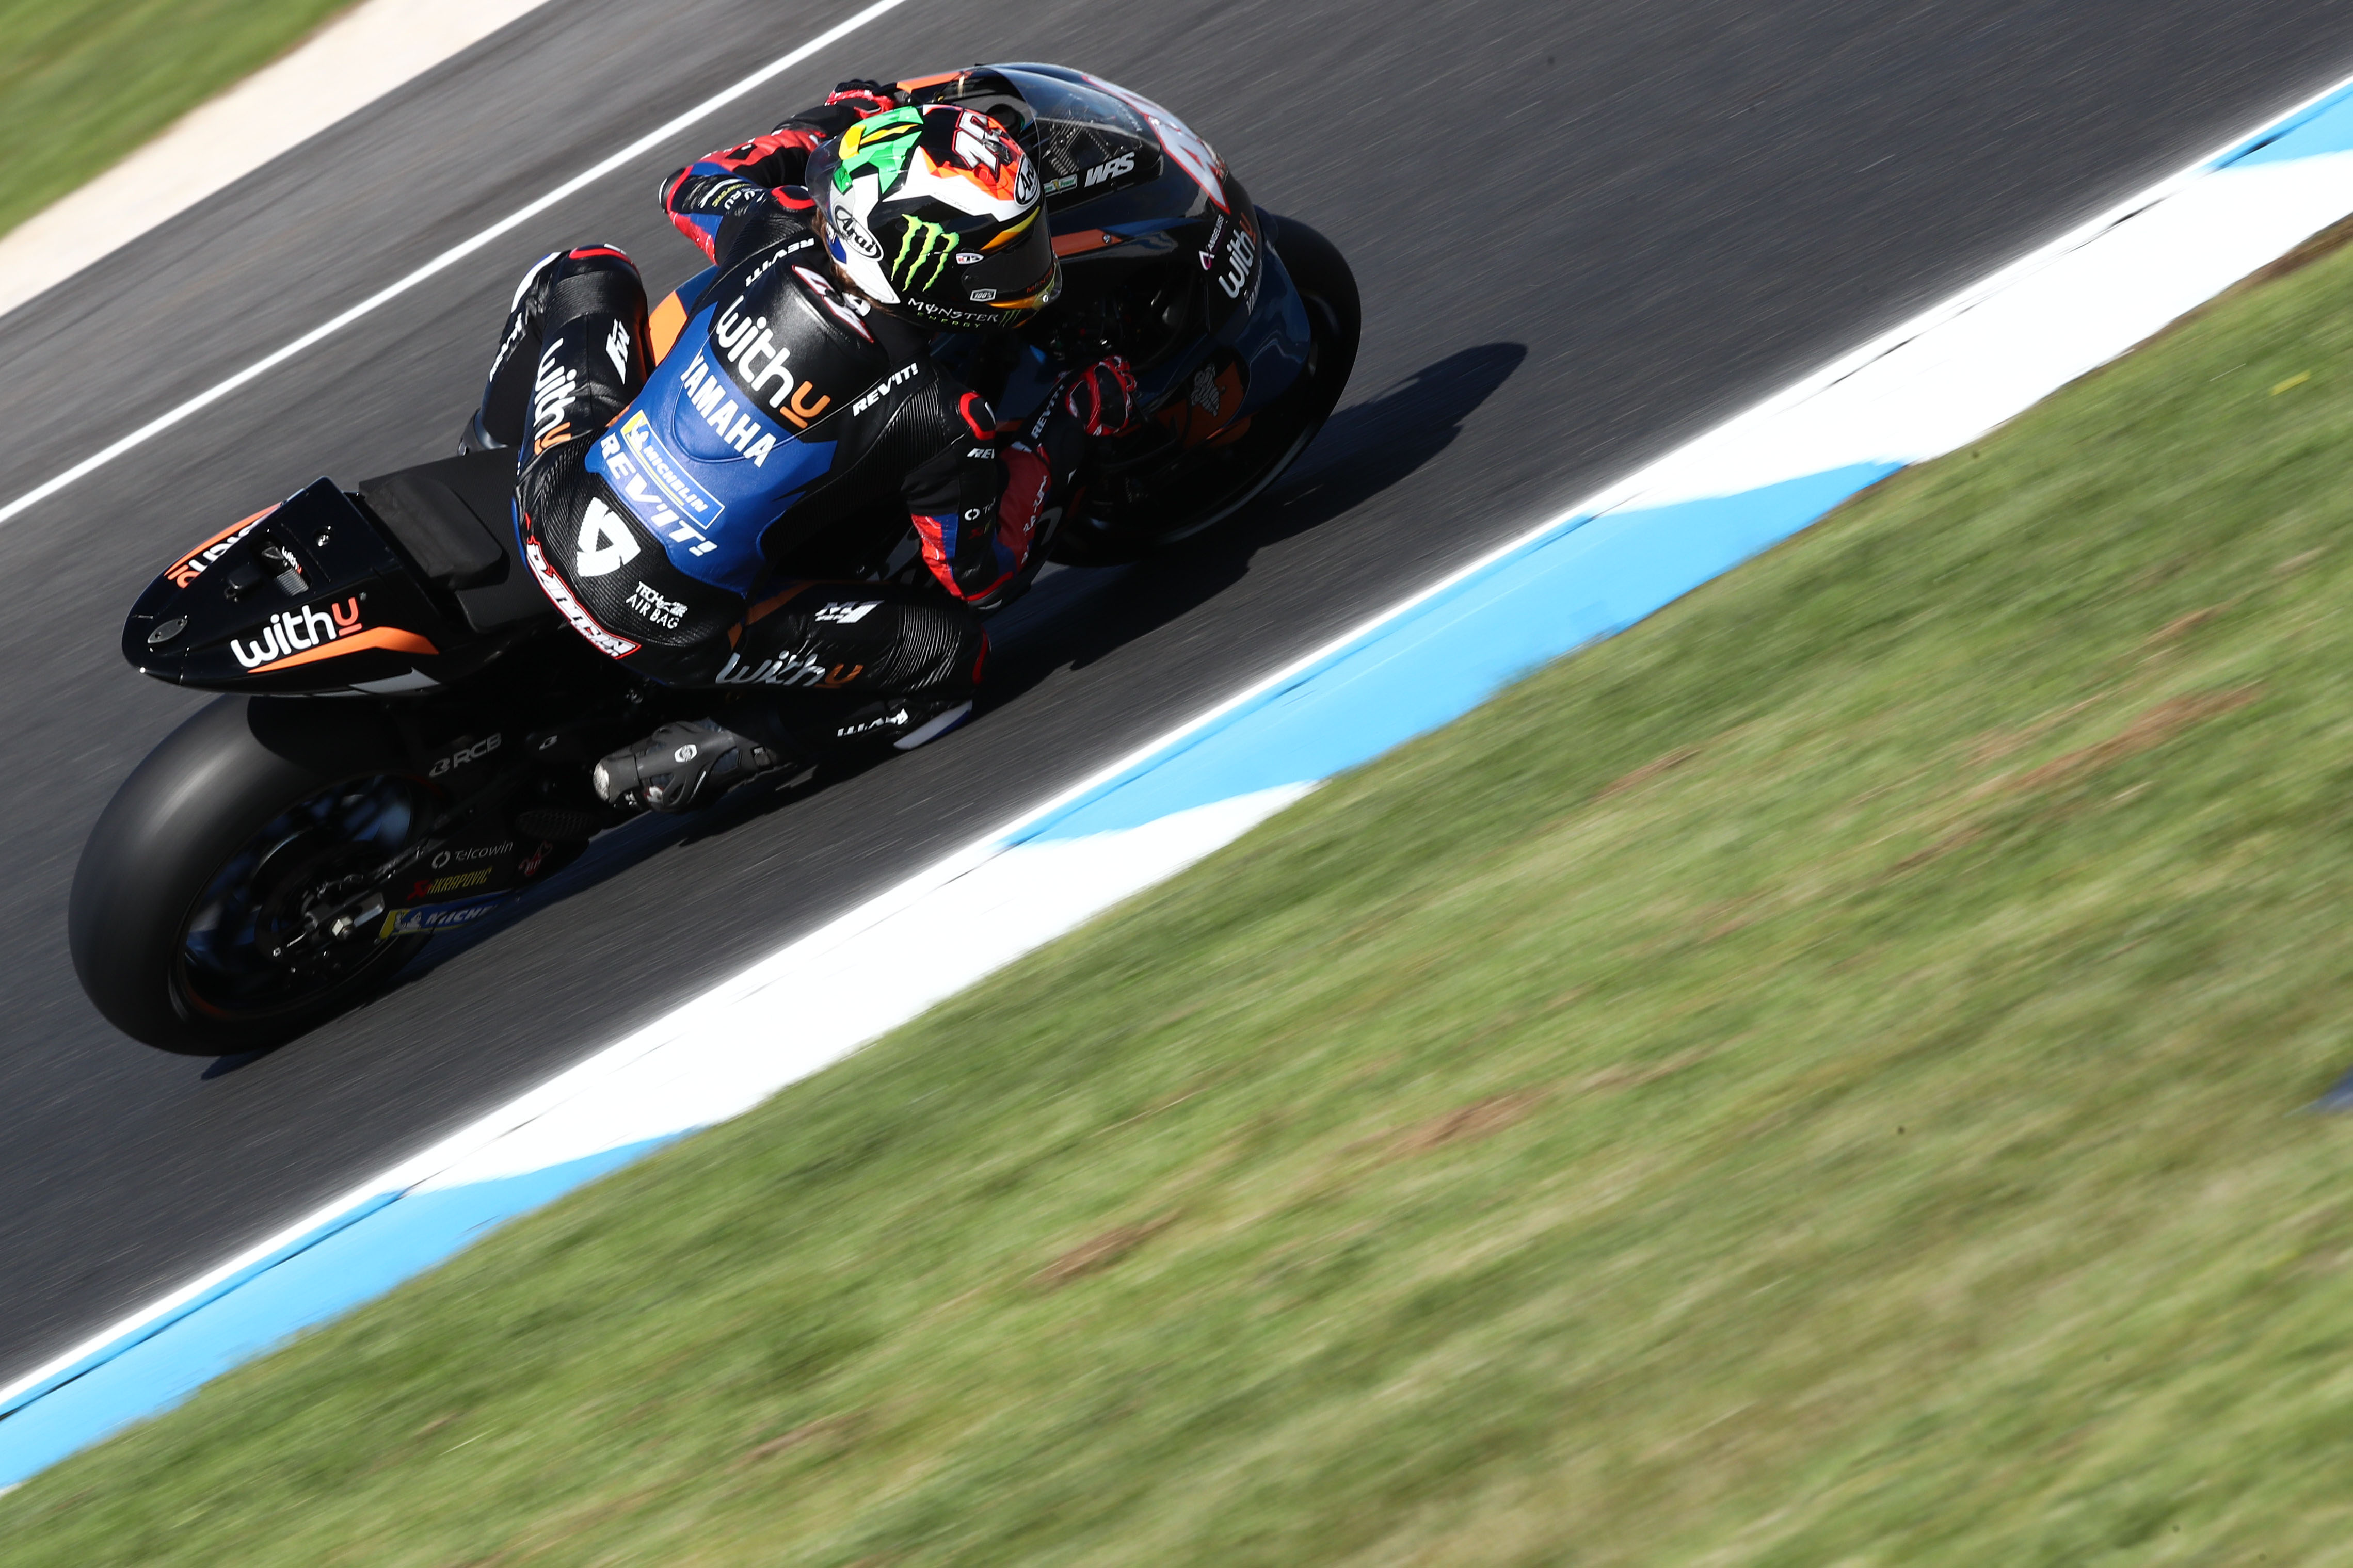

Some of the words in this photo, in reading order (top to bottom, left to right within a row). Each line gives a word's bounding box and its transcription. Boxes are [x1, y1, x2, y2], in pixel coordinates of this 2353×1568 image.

[1084, 152, 1135, 188] WRS
[836, 209, 876, 253] Arai
[908, 298, 999, 322] MONSTER
[973, 291, 993, 299] 100%
[917, 312, 981, 328] ENERGY
[679, 354, 777, 468] YAMAHA
[644, 444, 709, 514] MICHELIN
[626, 594, 651, 617] AIR
[649, 608, 680, 629] BAG
[453, 732, 502, 769] RCB
